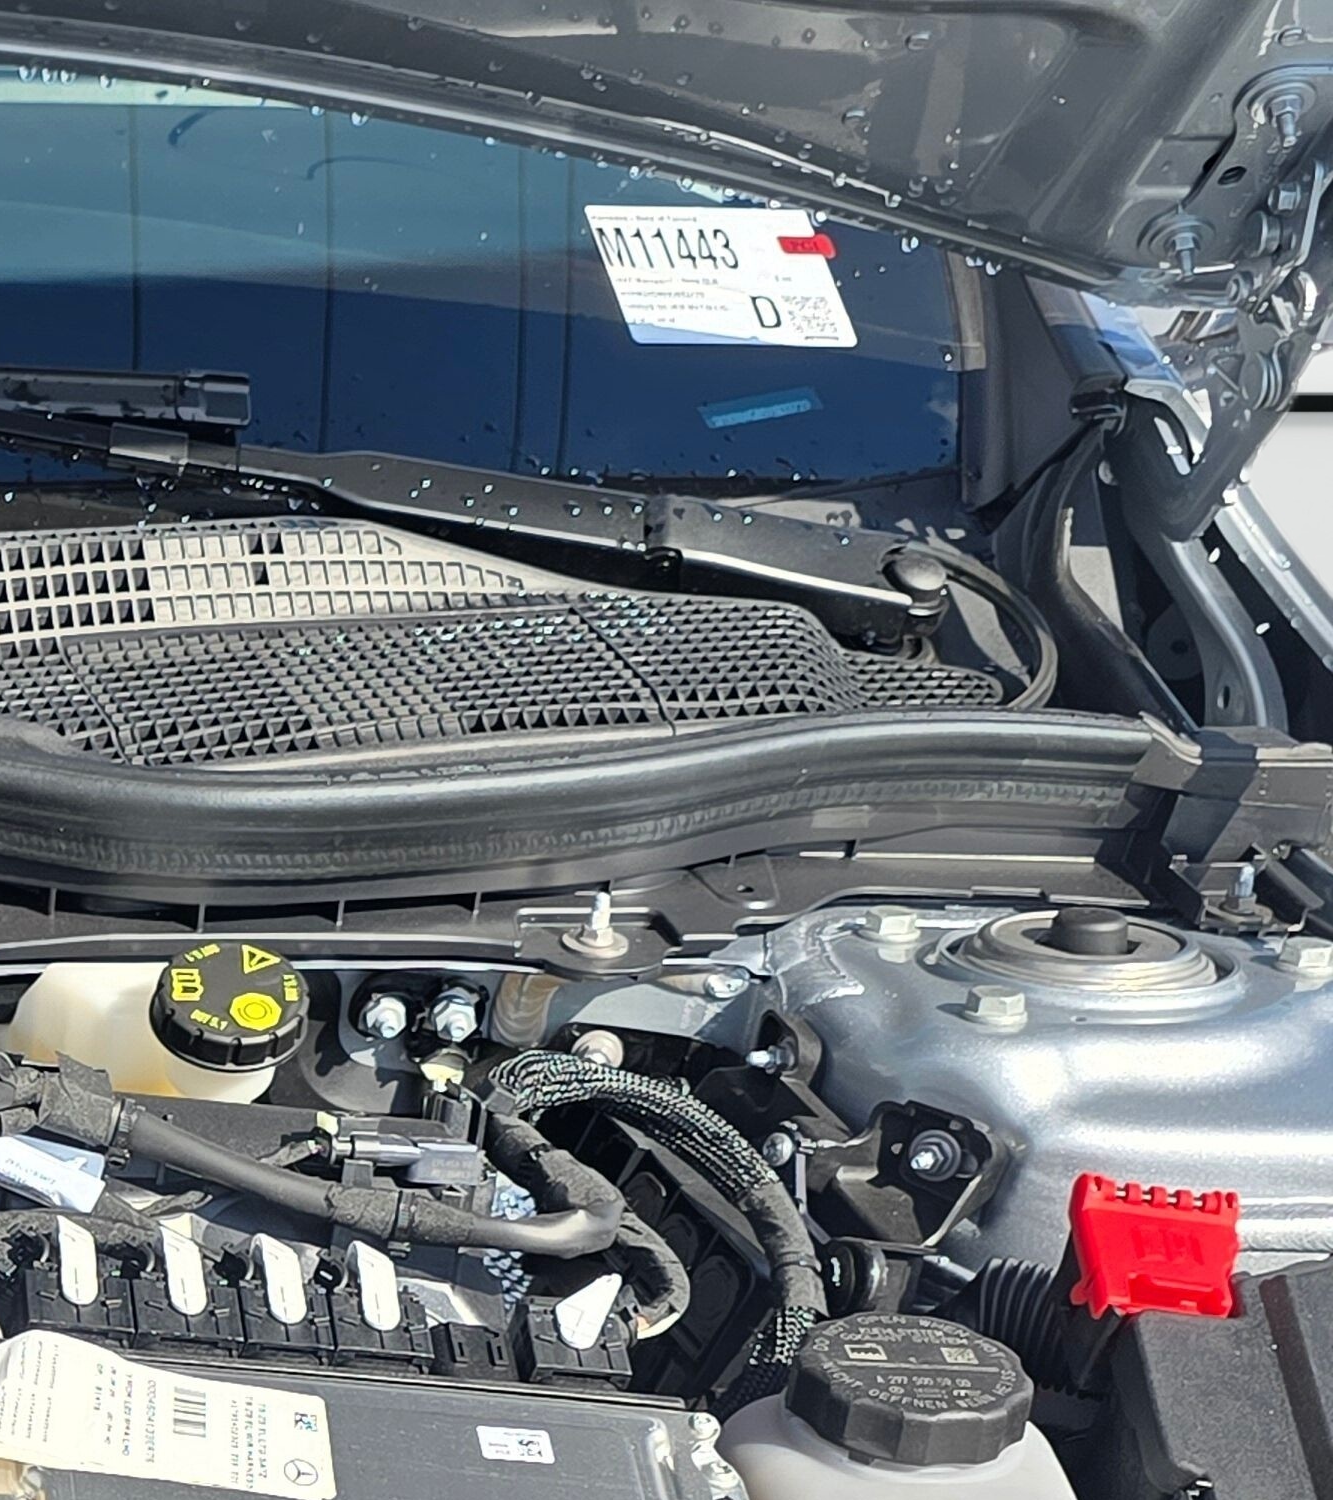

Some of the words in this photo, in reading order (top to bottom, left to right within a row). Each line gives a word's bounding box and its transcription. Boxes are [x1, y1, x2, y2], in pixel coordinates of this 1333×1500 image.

[595, 227, 739, 270] M11443
[749, 294, 782, 329] D
[856, 1315, 907, 1326] OPEN
[918, 1318, 971, 1339] WHEN
[868, 1388, 949, 1410] OEFFNEN
